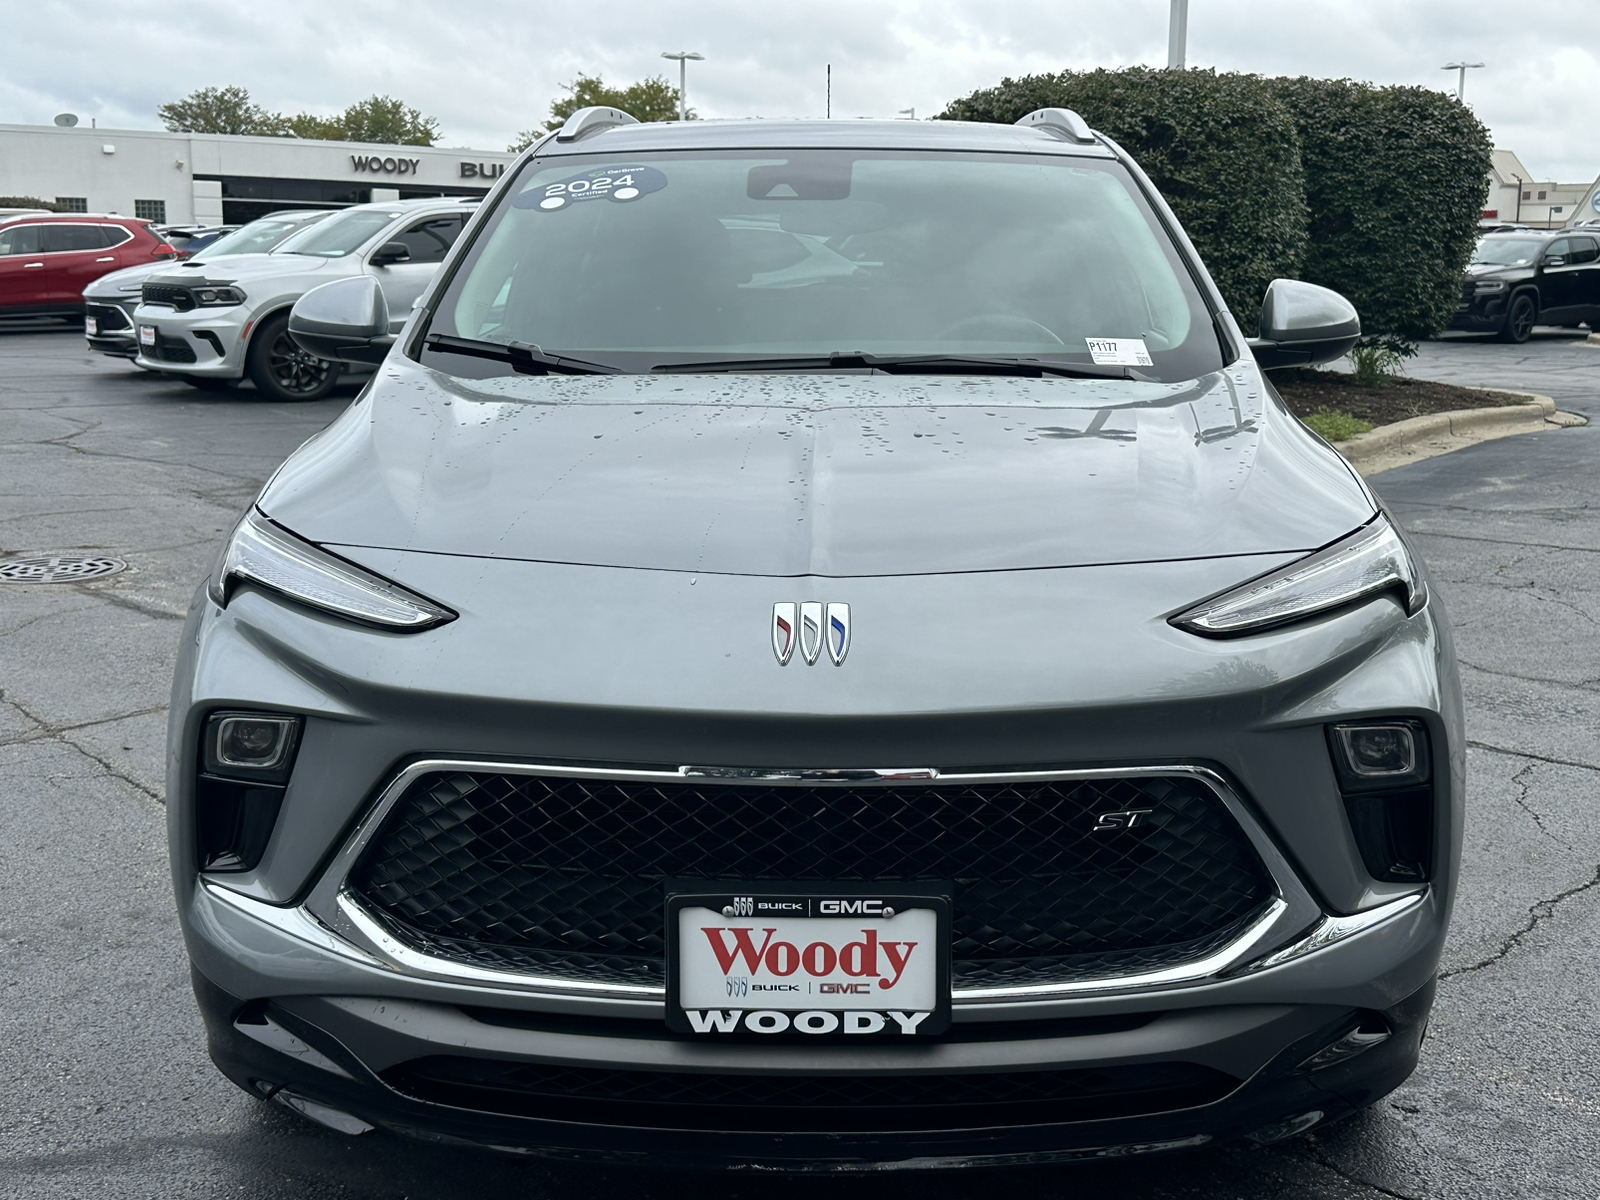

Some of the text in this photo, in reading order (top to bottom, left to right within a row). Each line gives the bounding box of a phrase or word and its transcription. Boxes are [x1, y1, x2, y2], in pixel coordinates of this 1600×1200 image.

[351, 155, 420, 175] WOODY
[545, 174, 635, 198] 2024
[571, 189, 608, 198] Certified
[1089, 342, 1117, 351] P1177
[1093, 810, 1153, 831] ST
[758, 900, 883, 914] BUICK GMC
[700, 927, 919, 990] Woody
[751, 983, 871, 995] BUICK GMC
[685, 1010, 932, 1035] WOODY
